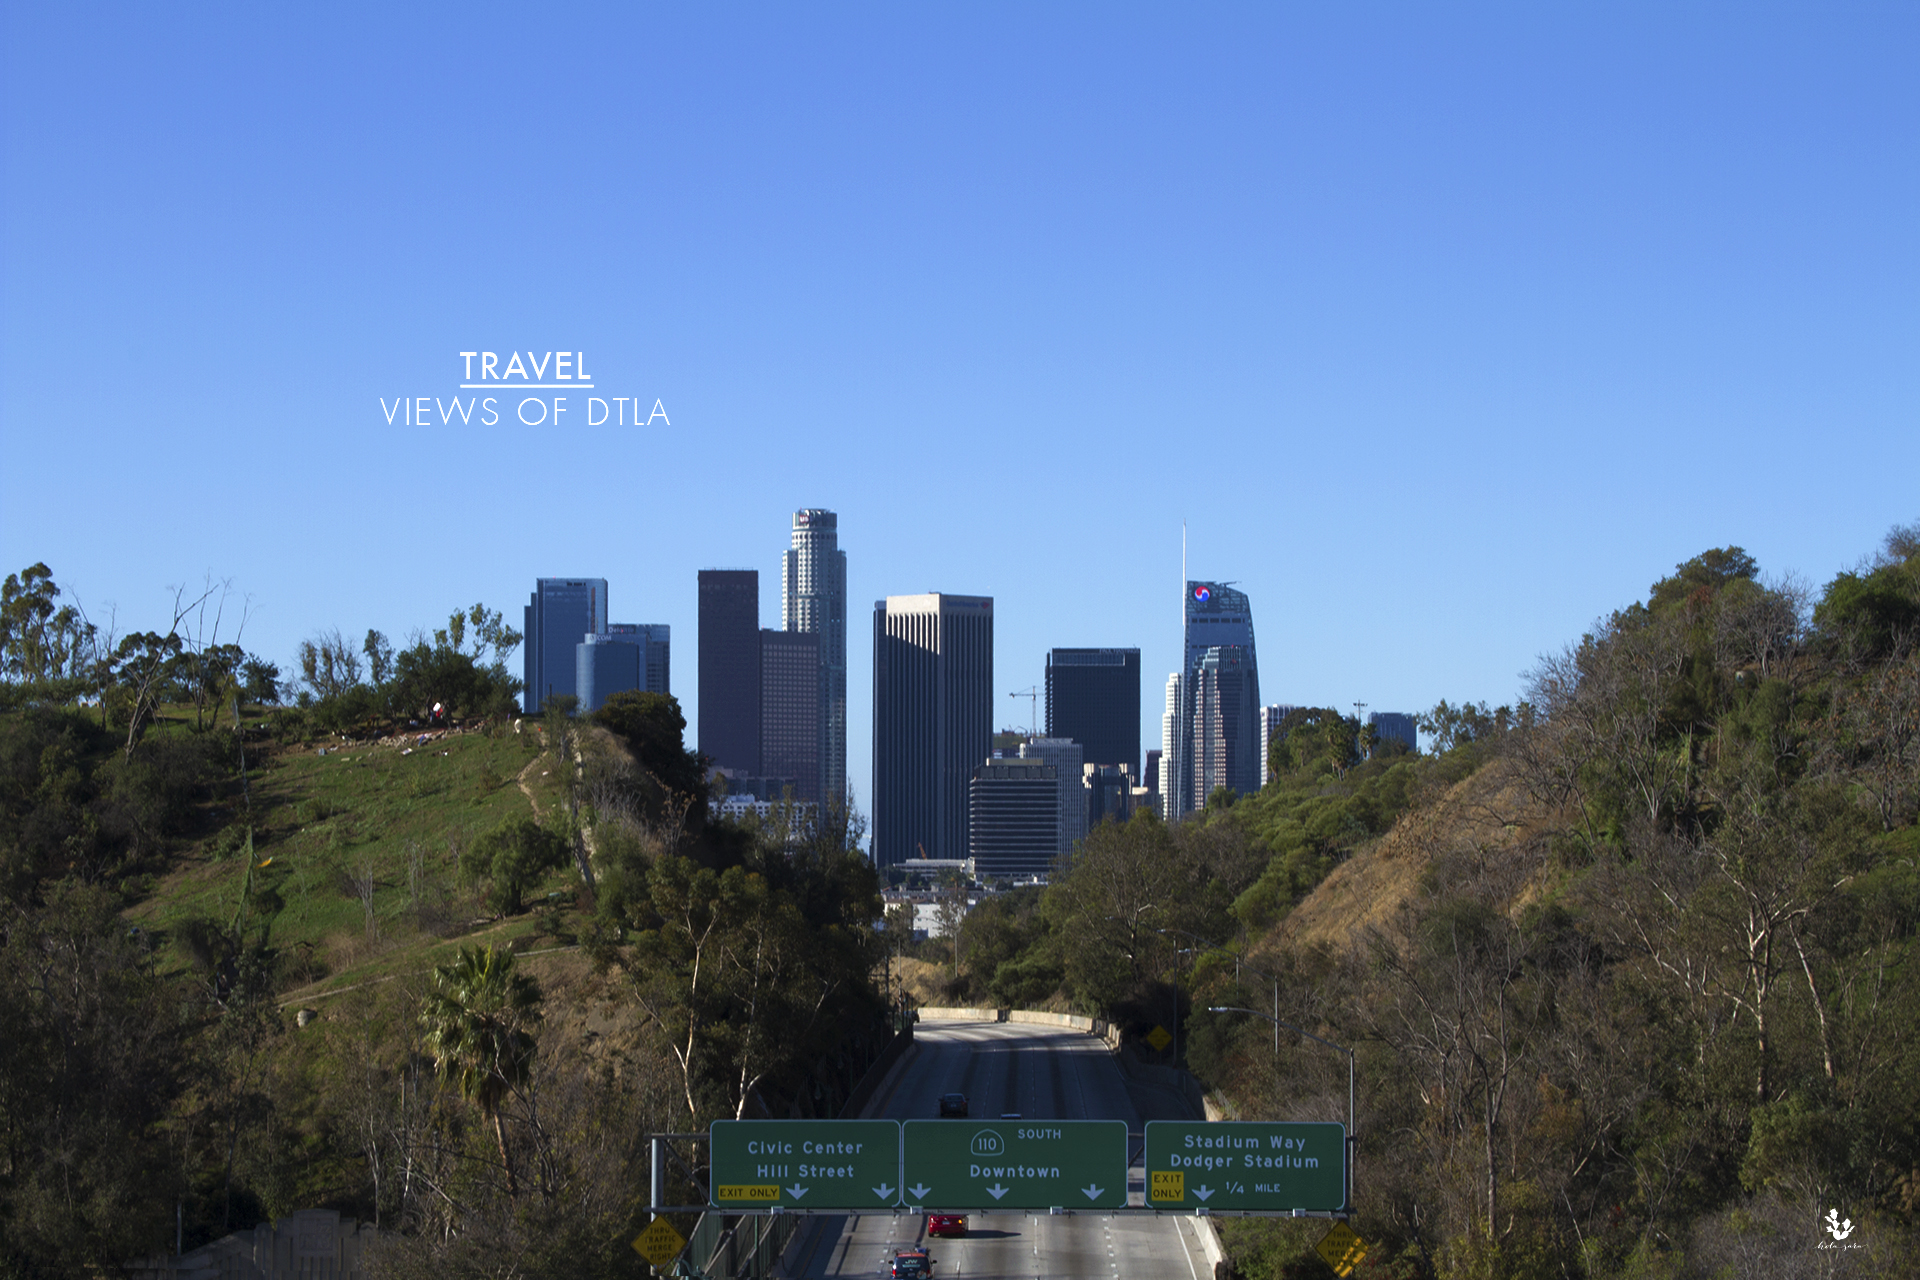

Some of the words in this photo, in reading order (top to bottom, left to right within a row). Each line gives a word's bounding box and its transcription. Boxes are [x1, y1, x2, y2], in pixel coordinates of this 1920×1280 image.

[1017, 1128, 1062, 1140] SOUTH
[747, 1140, 792, 1155] Civic
[802, 1140, 864, 1155] Center
[977, 1137, 997, 1151] 110
[1184, 1134, 1260, 1149] Stadium
[1269, 1135, 1306, 1152] Way
[1170, 1153, 1233, 1171] Dodger
[1244, 1155, 1319, 1169] Stadium
[757, 1164, 789, 1178] Hill
[798, 1164, 854, 1178] Street
[970, 1164, 1060, 1178] Downtown
[1153, 1174, 1182, 1184] EXIT
[719, 1188, 744, 1198] EXIT
[749, 1188, 778, 1198] ONLY
[1255, 1183, 1281, 1193] MILE
[1152, 1189, 1182, 1198] ONLY
[650, 1226, 671, 1234] THRU
[1333, 1231, 1353, 1239] THRU
[644, 1234, 676, 1243] TRAFFIC
[646, 1243, 673, 1252] MERGE
[1327, 1240, 1359, 1248] TRAFFIC
[650, 1252, 671, 1260] RIGHT
[1327, 1250, 1356, 1258] MERGE
